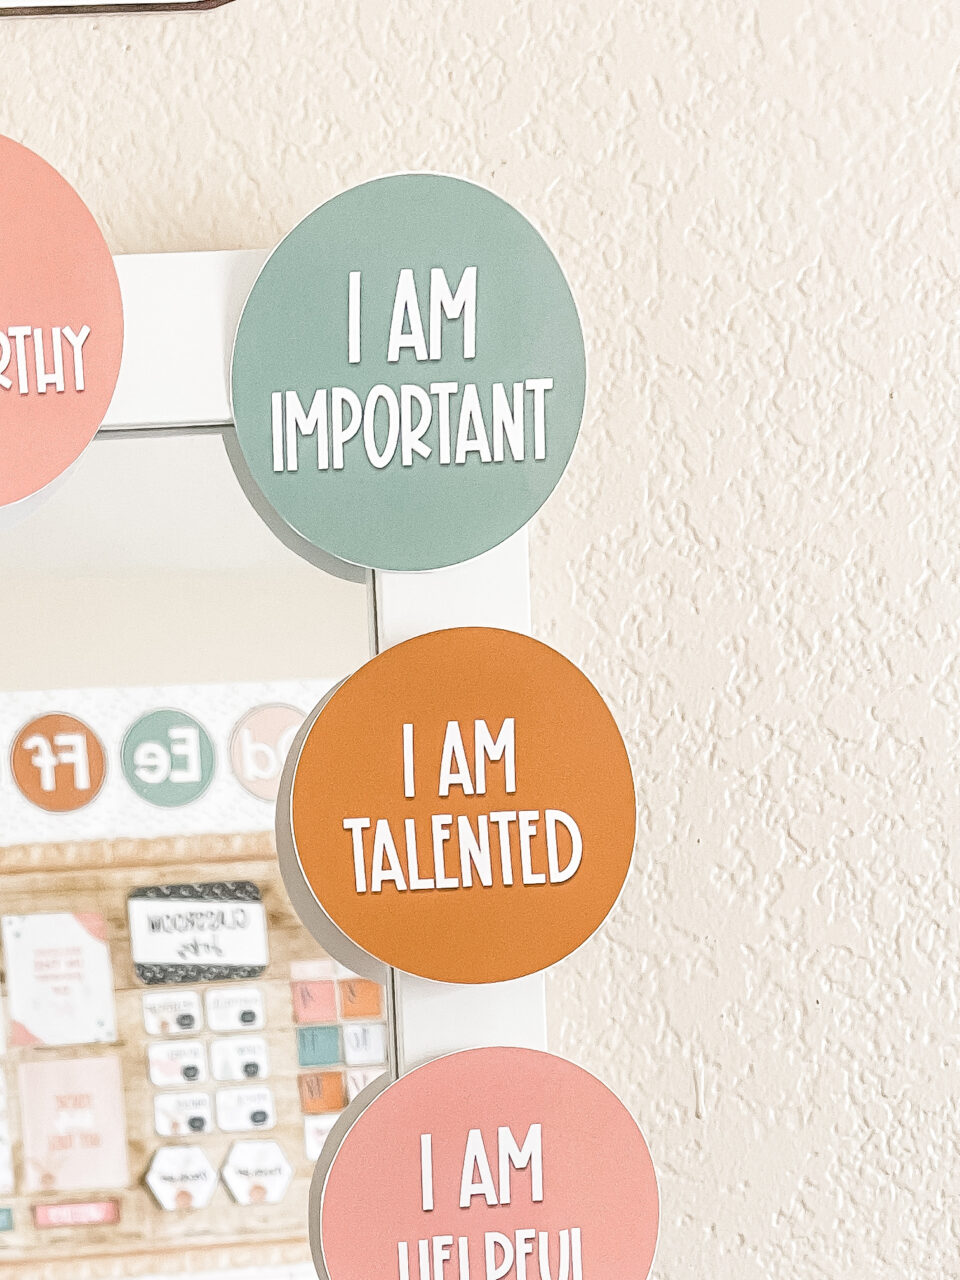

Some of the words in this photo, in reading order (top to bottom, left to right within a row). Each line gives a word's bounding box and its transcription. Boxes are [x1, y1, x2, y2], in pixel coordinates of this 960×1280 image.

[348, 271, 361, 363] I
[387, 266, 477, 362] AM
[271, 377, 554, 472] IMPORTANT
[402, 723, 415, 798] I
[438, 717, 516, 796] AM
[342, 809, 583, 893] TALENTED
[420, 1133, 434, 1211] I
[459, 1123, 543, 1208] AM
